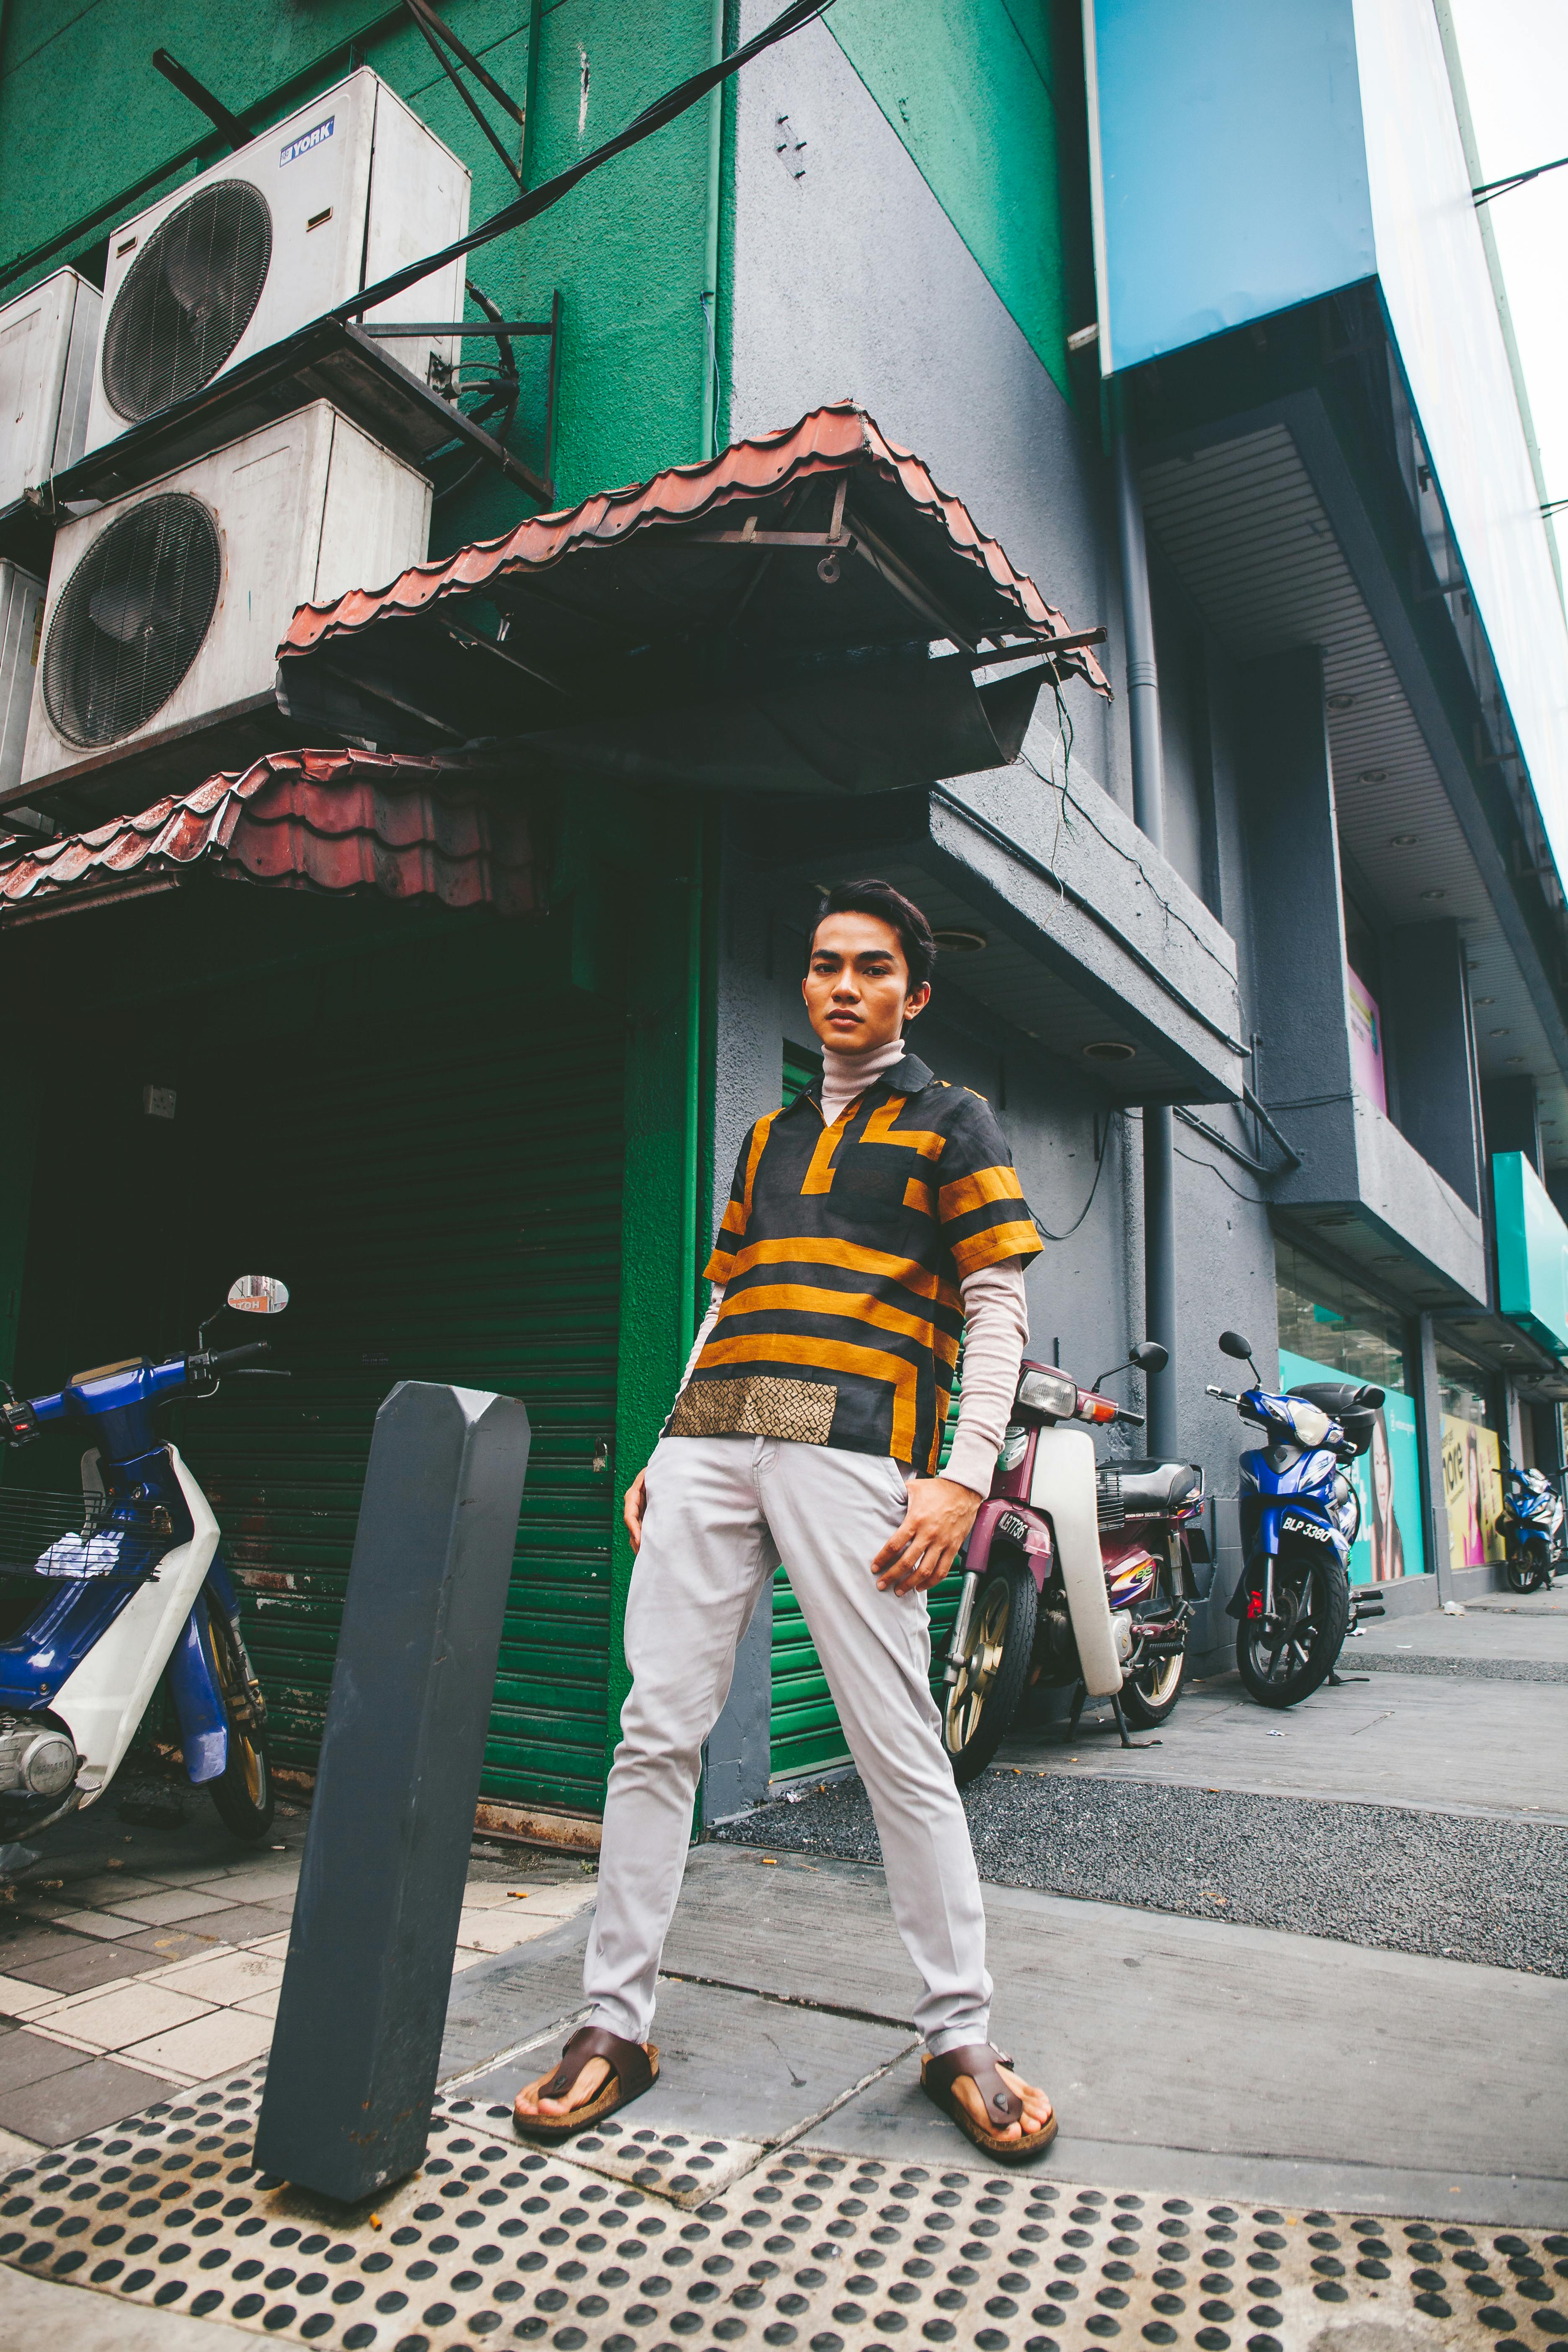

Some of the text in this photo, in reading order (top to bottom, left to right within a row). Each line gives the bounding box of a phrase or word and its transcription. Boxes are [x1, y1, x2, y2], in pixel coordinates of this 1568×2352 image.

[293, 121, 330, 157] YORK
[1282, 1517, 1331, 1542] BLP 3380
